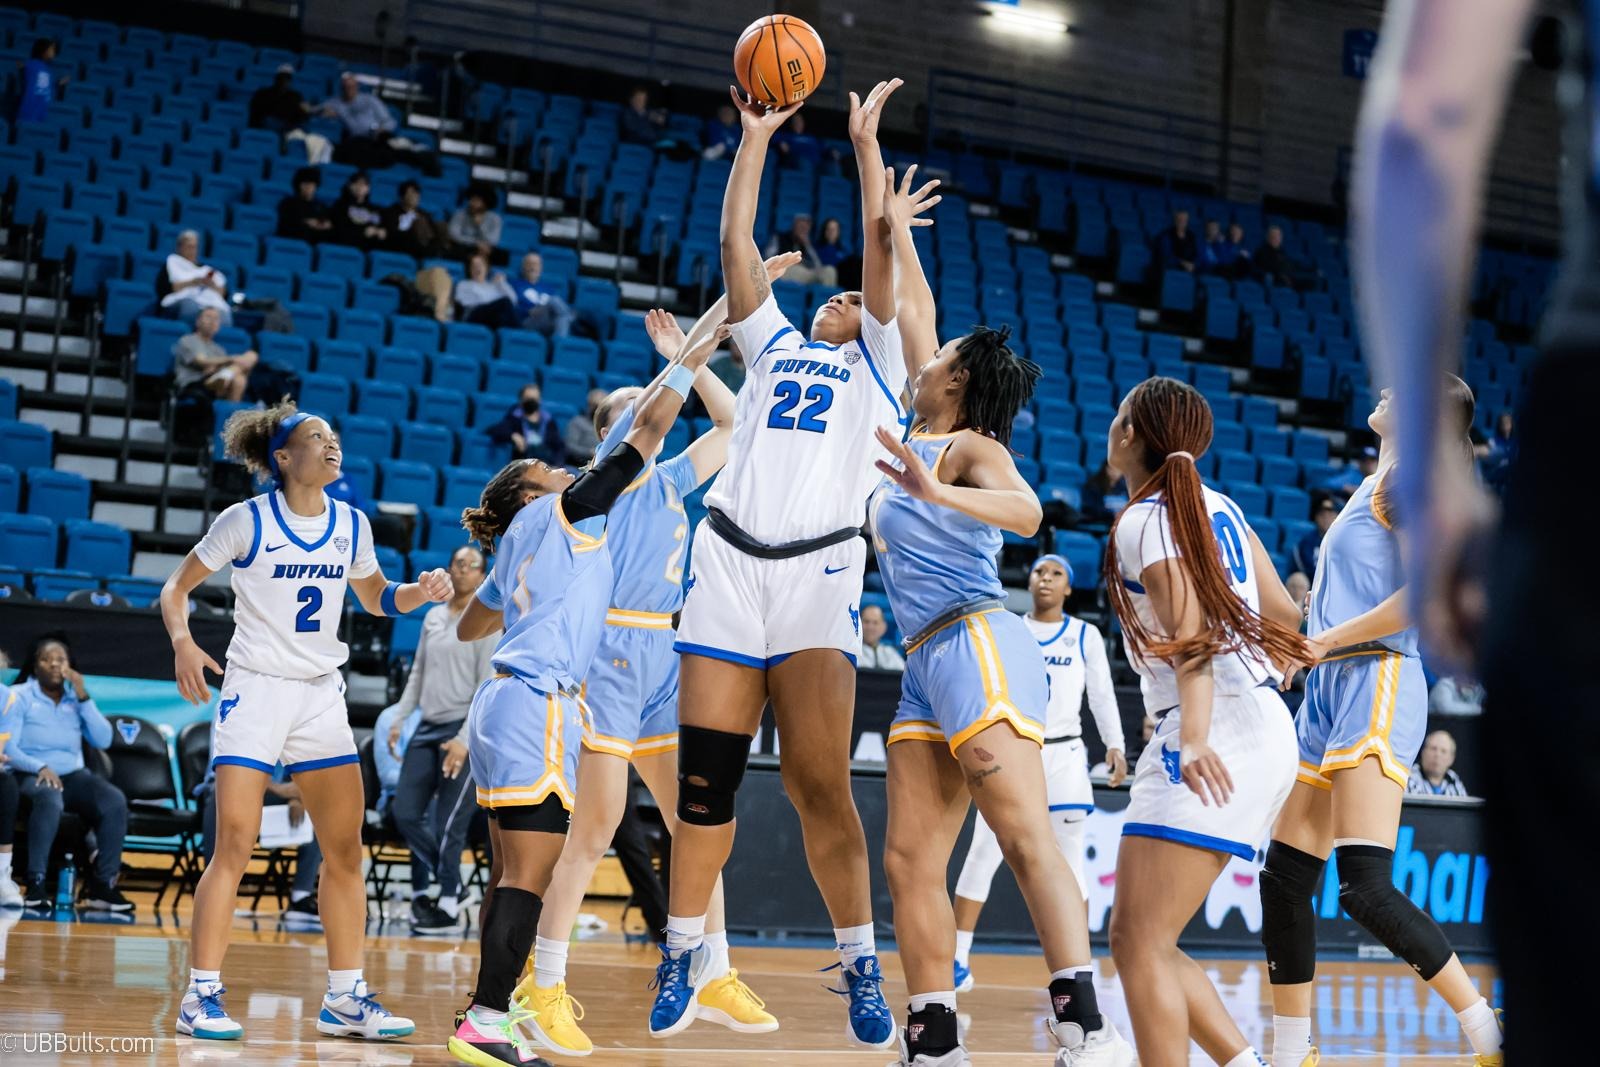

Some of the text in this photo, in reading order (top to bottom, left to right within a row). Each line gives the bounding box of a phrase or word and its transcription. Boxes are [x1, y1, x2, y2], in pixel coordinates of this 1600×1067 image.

[786, 58, 806, 101] ELITE
[769, 358, 851, 383] BUFFALO
[767, 380, 834, 434] 22
[270, 564, 344, 579] BUFFALO
[295, 585, 323, 632] 2
